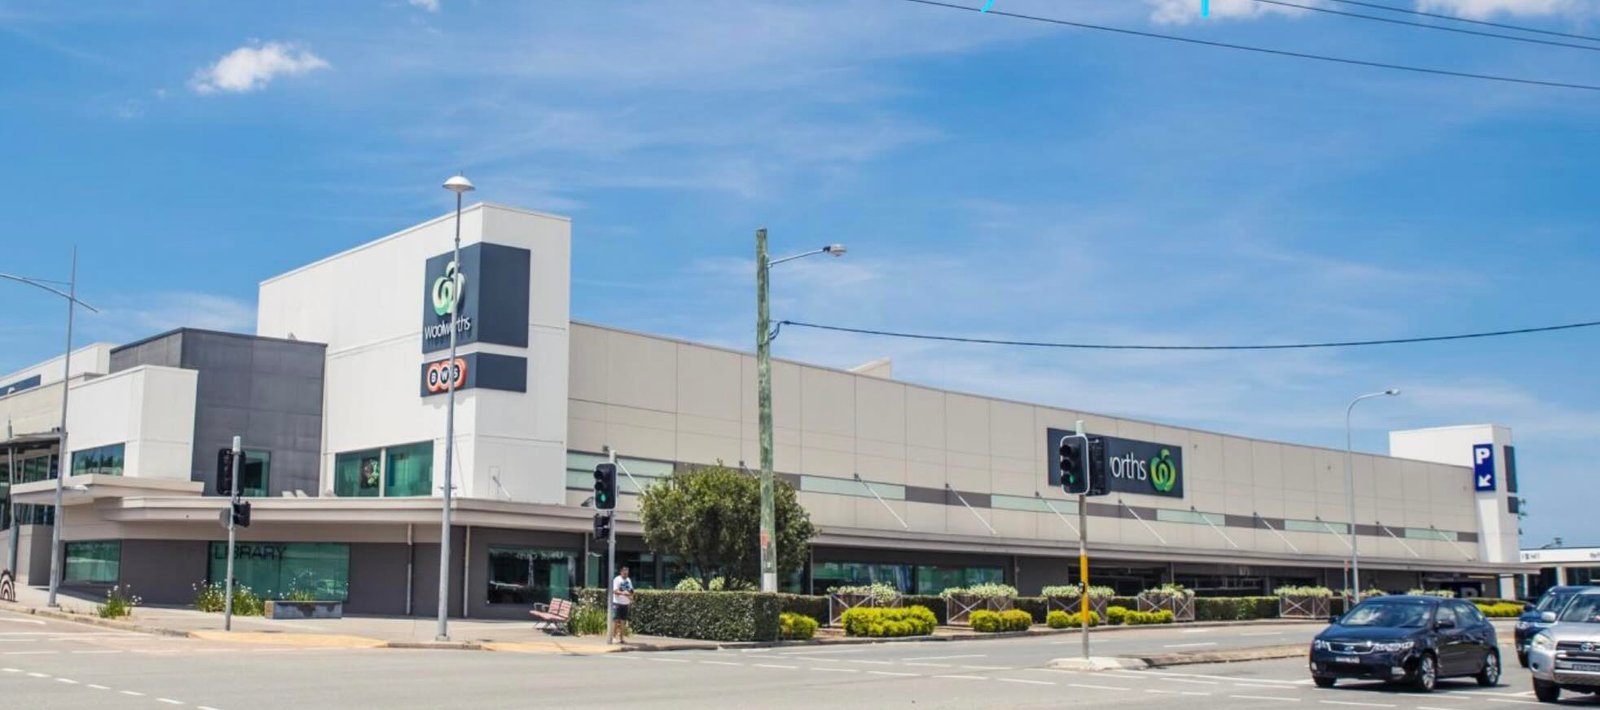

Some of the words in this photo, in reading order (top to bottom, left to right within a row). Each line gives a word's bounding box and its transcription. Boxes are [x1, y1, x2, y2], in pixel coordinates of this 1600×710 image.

[424, 315, 471, 340] Woolwths
[431, 367, 458, 383] BWS
[1475, 448, 1491, 464] P
[1109, 452, 1147, 481] orths
